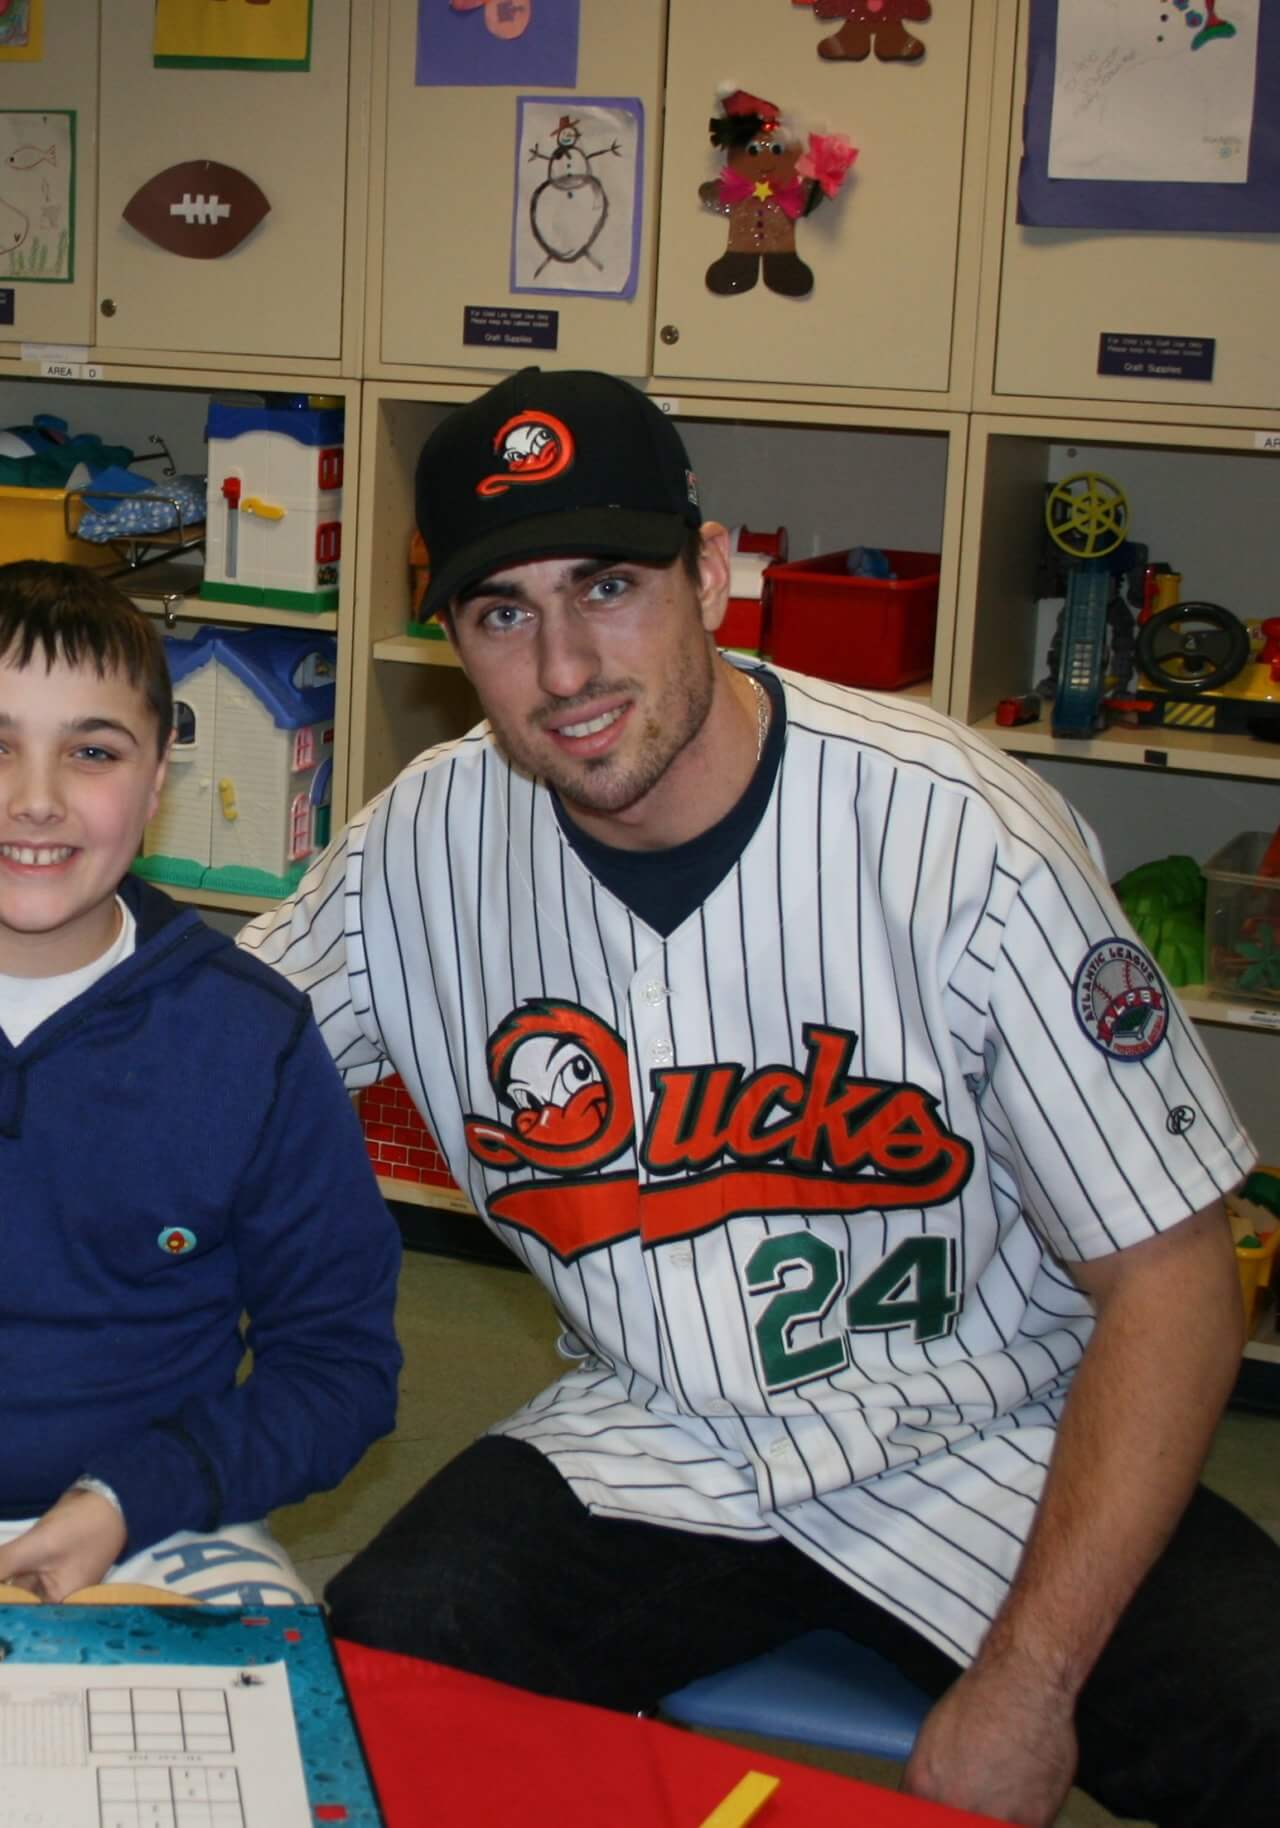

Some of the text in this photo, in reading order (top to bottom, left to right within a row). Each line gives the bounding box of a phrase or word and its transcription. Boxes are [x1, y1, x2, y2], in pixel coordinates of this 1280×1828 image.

[47, 366, 72, 377] AREA
[1081, 952, 1106, 1023] ATLANTIC
[463, 997, 975, 1190] Ducks
[743, 1228, 963, 1396] 24
